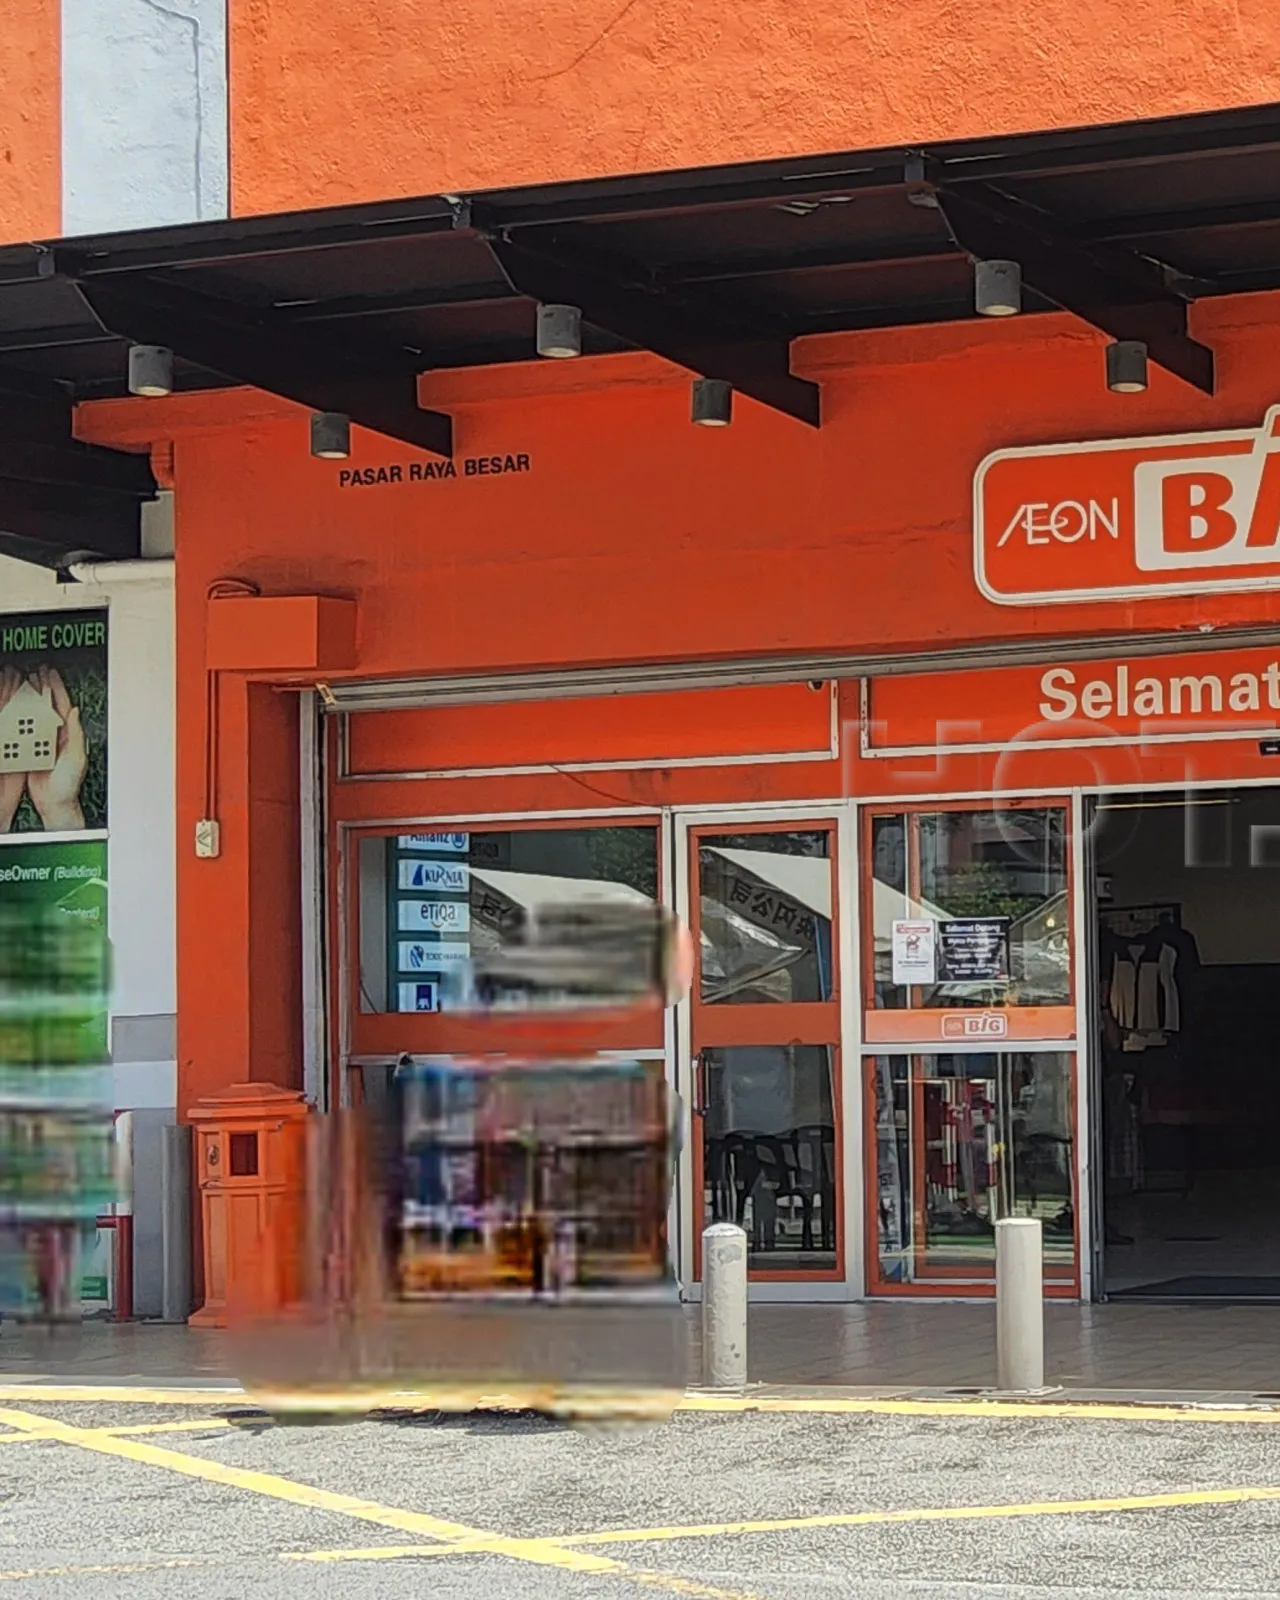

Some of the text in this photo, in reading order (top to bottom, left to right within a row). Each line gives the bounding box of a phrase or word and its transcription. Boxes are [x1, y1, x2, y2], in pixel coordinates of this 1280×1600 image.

[339, 453, 530, 487] PASAR RAYA BESAR
[2, 621, 105, 650] HOME COVER
